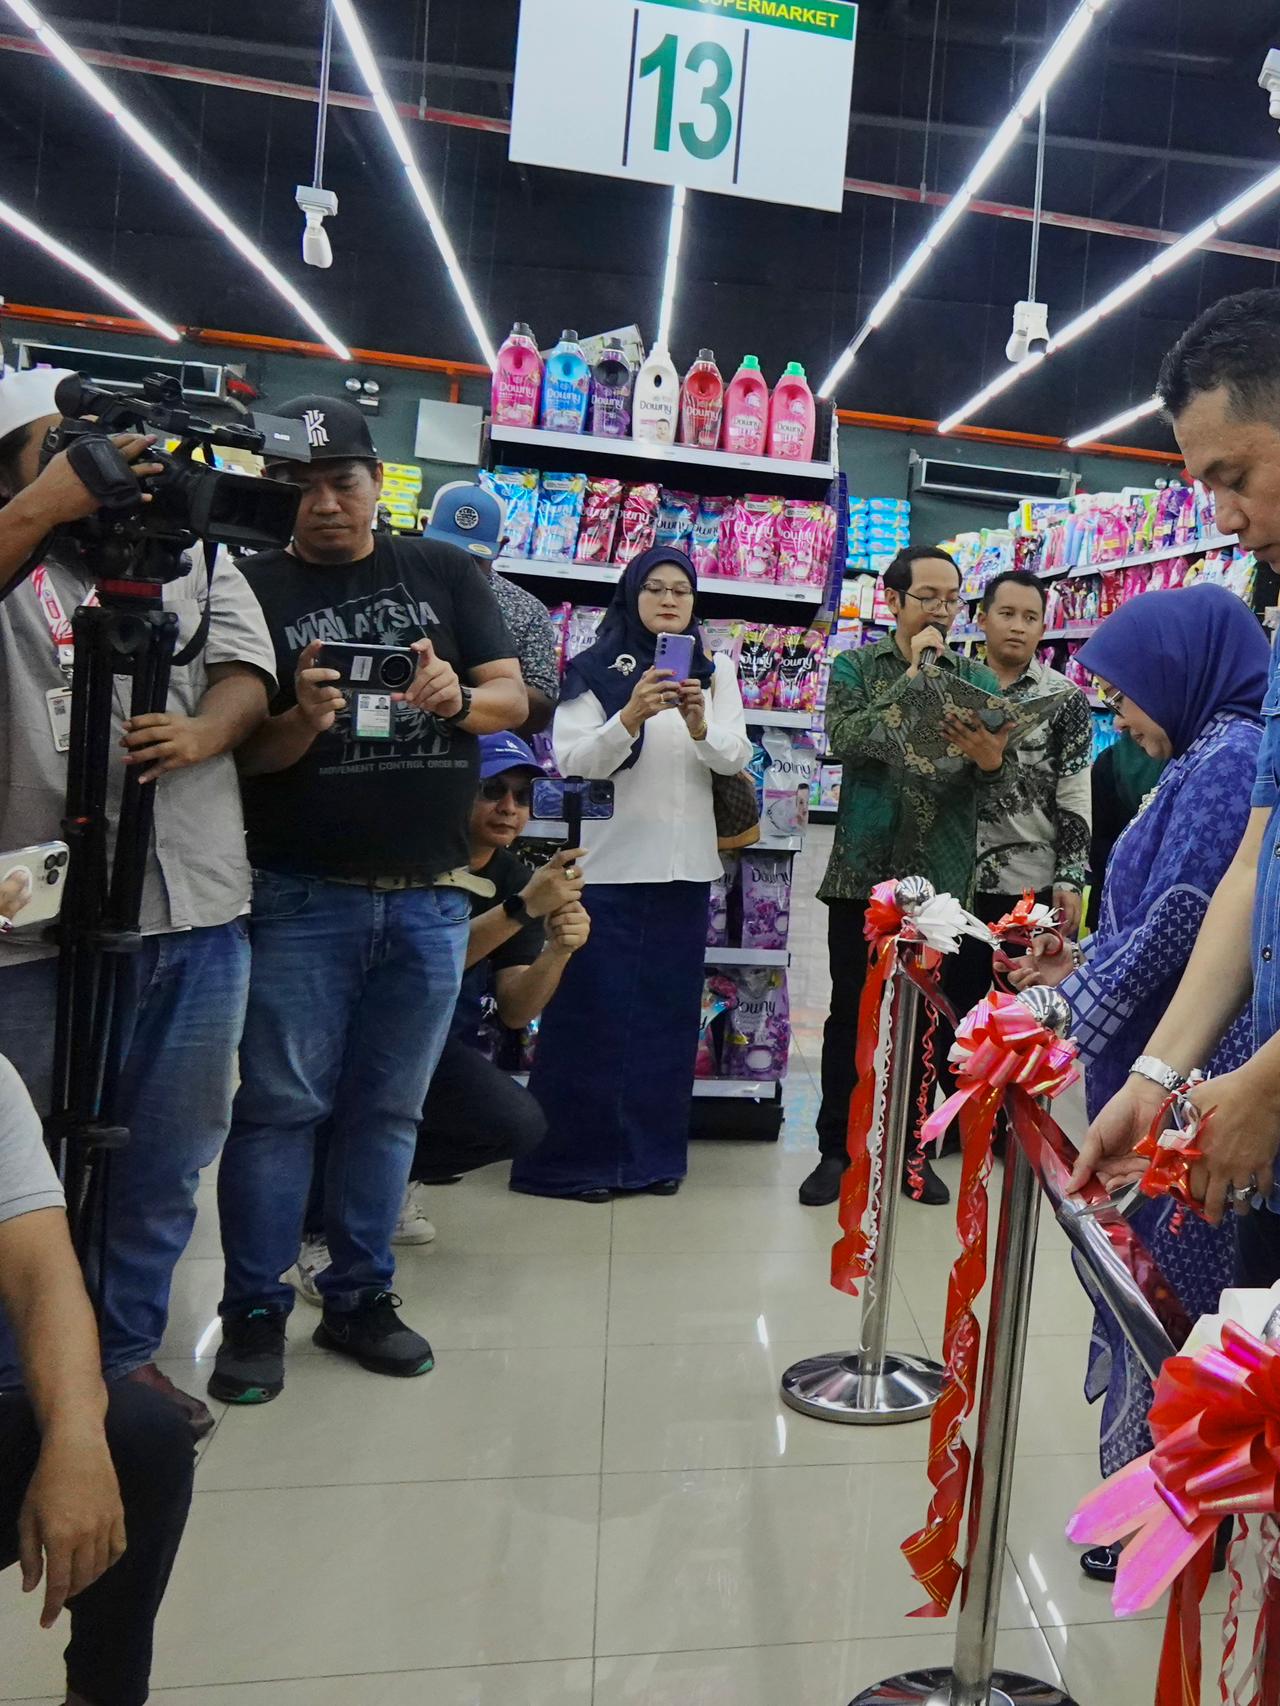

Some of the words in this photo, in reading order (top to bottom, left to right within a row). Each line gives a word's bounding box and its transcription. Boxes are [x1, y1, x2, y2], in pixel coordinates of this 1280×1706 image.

[639, 33, 734, 160] 13
[500, 382, 535, 399] Downy
[547, 389, 581, 404] Downy
[591, 394, 625, 410] Downy
[639, 400, 672, 414] Downy
[686, 405, 720, 421] Downy
[734, 416, 761, 430] Downy
[777, 423, 804, 436] Downy
[284, 601, 440, 650] MALAYSIA
[379, 760, 425, 771] CONTROL
